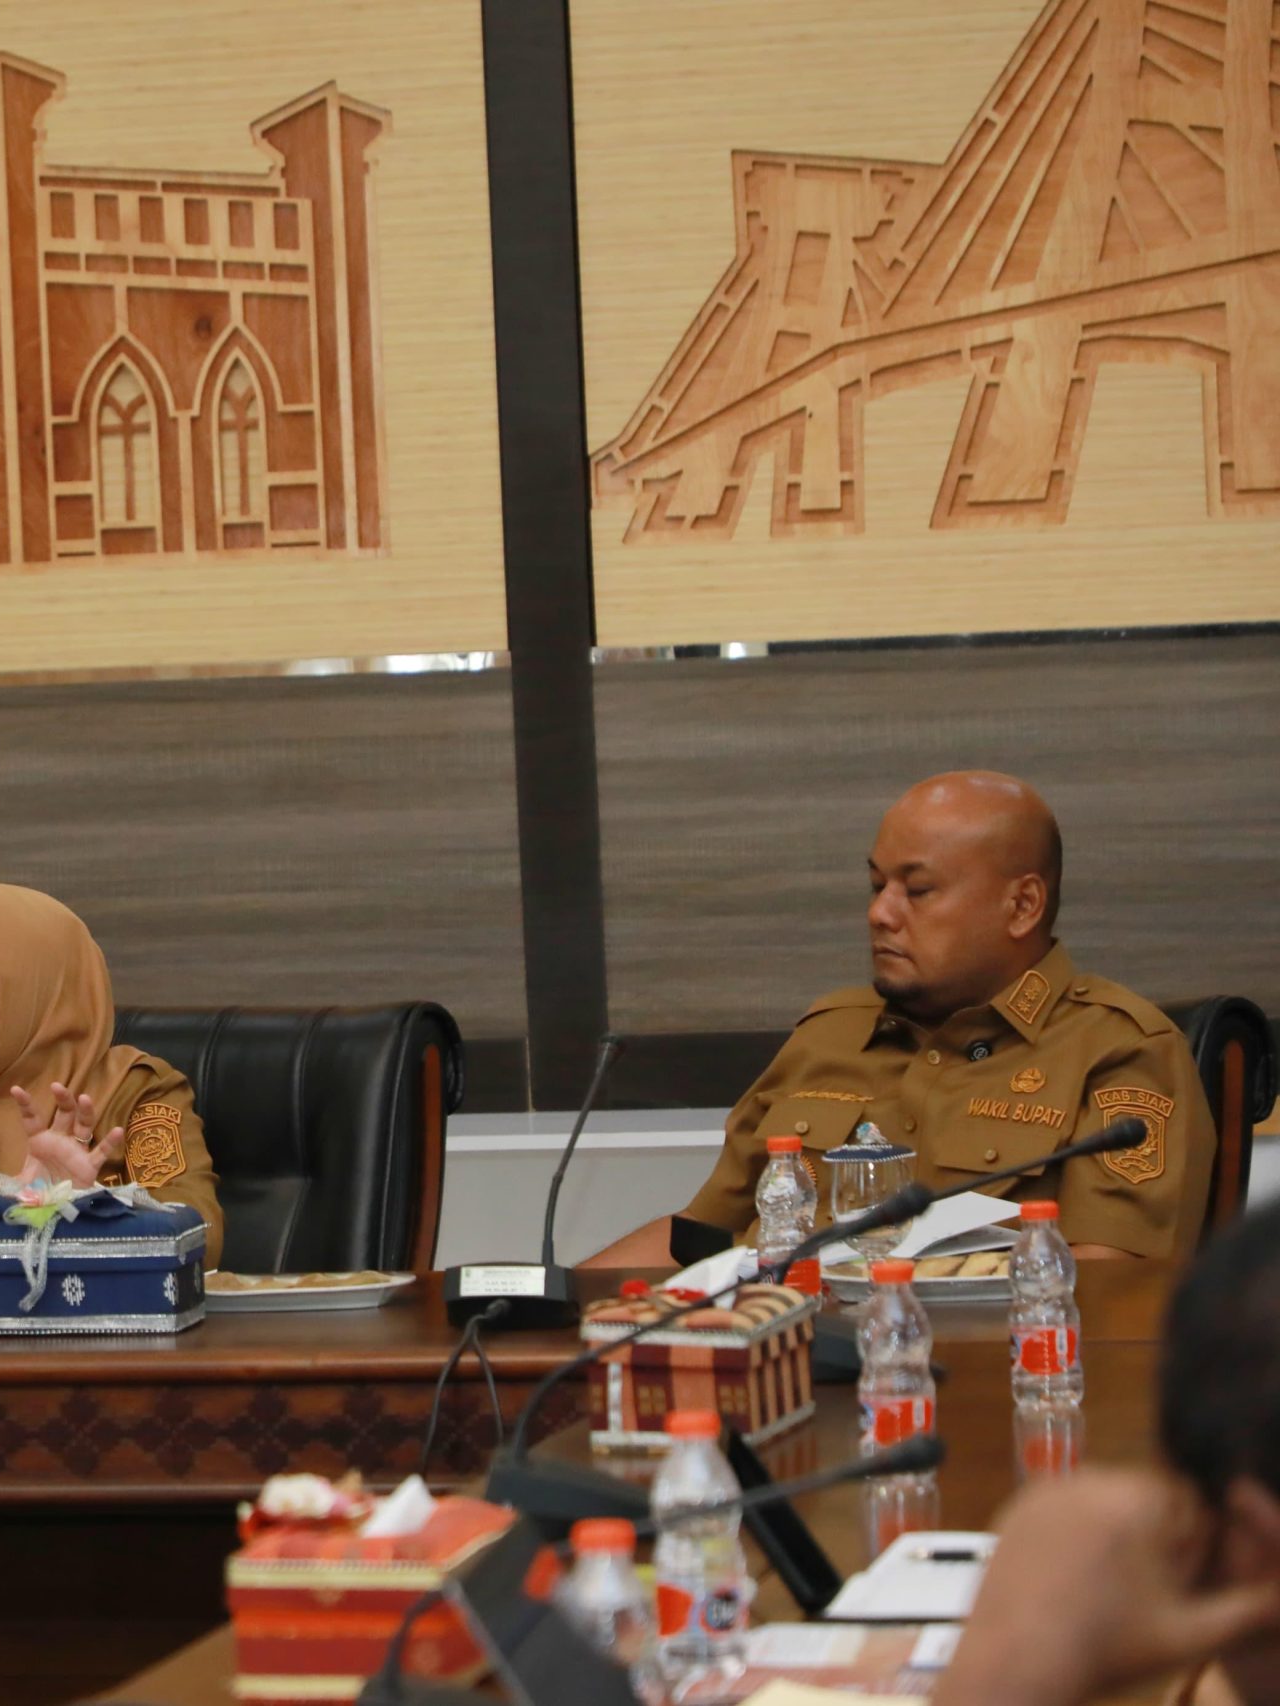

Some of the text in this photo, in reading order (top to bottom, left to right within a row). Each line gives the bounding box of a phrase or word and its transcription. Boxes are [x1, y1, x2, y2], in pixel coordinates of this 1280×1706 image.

[144, 1105, 179, 1120] SIAK
[968, 1097, 1068, 1129] WAKIL BUPATI
[1136, 1091, 1170, 1113] SIAK
